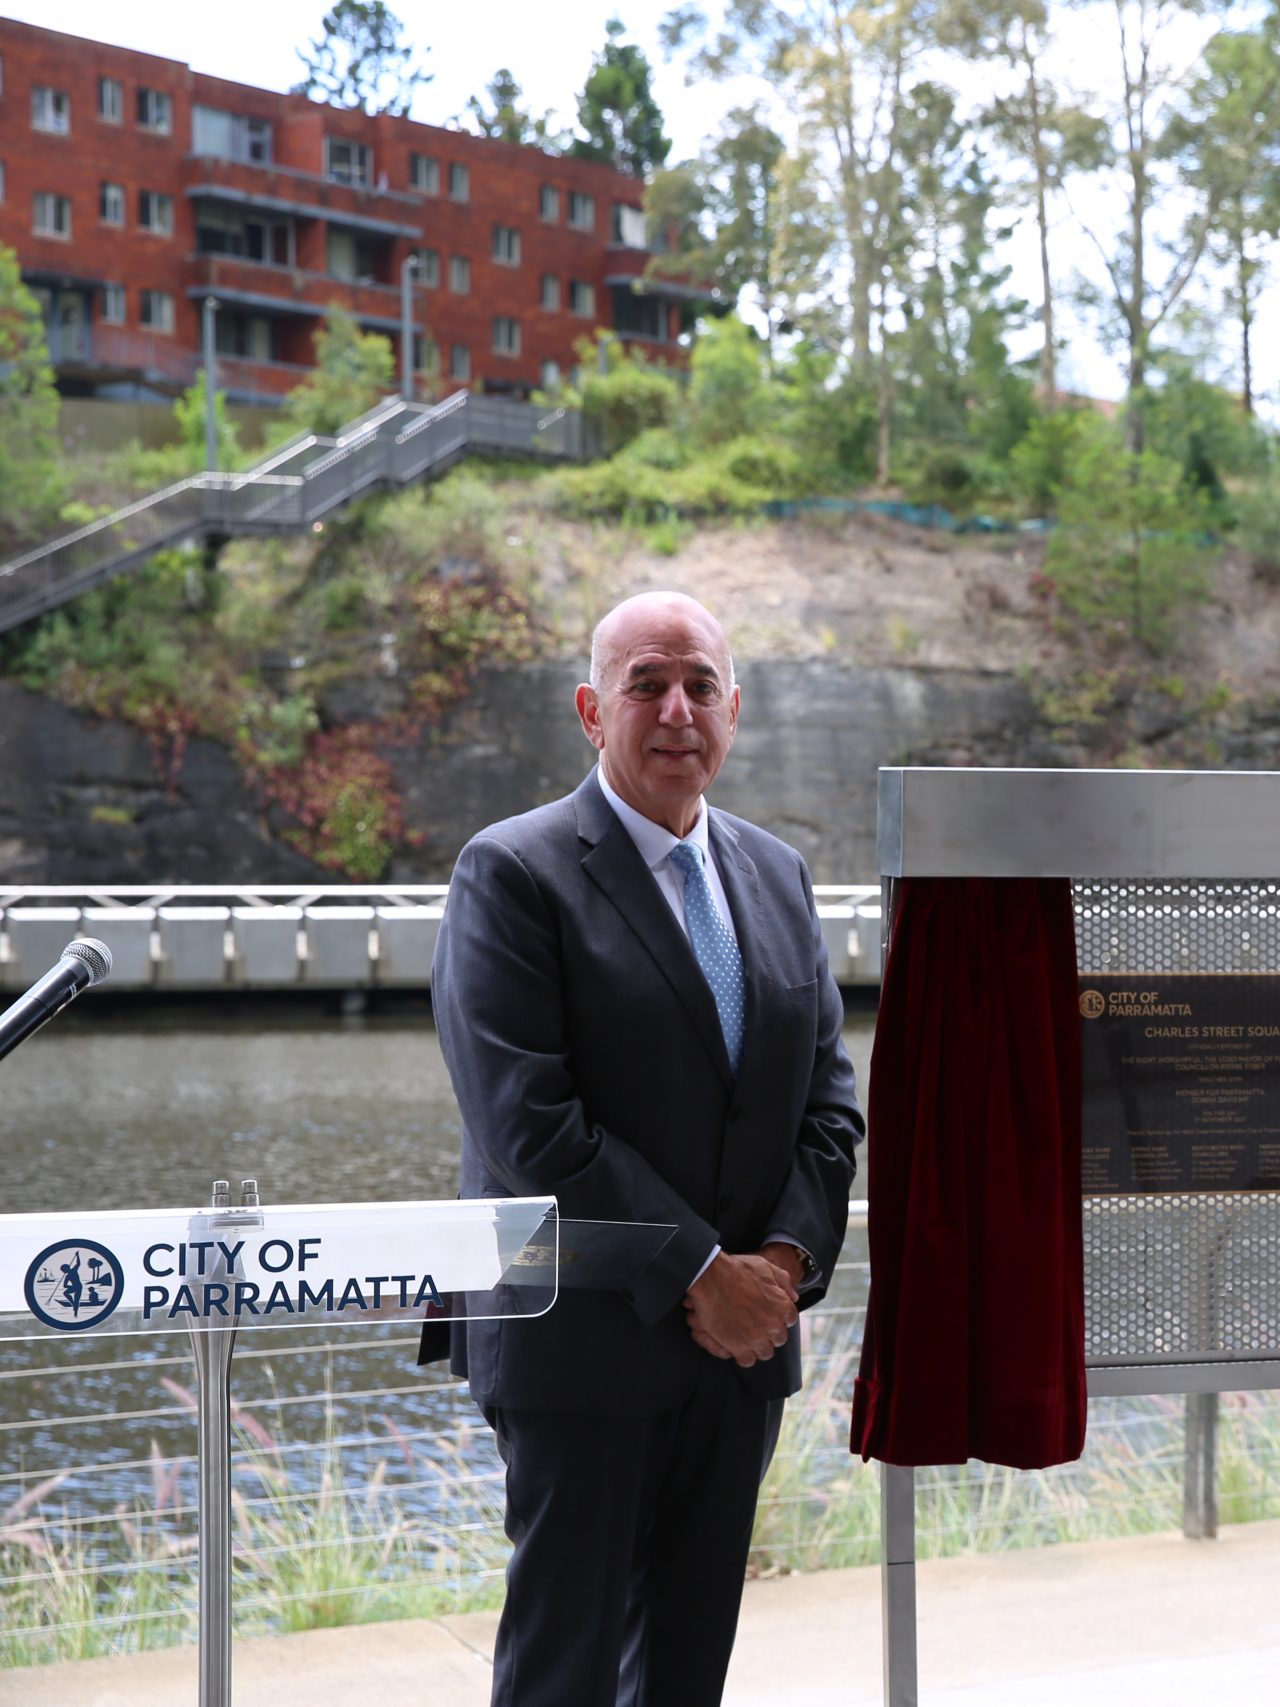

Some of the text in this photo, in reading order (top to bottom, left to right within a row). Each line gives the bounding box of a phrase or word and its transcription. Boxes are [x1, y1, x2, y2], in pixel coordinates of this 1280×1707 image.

[1109, 992, 1158, 1004] CITY OF
[1109, 1004, 1192, 1017] PARRAMATTA
[1145, 1027, 1199, 1038] CHARLES
[1202, 1026, 1244, 1037] STREET
[143, 1237, 322, 1277] CITY OF
[143, 1275, 444, 1320] PARRAMATTA
